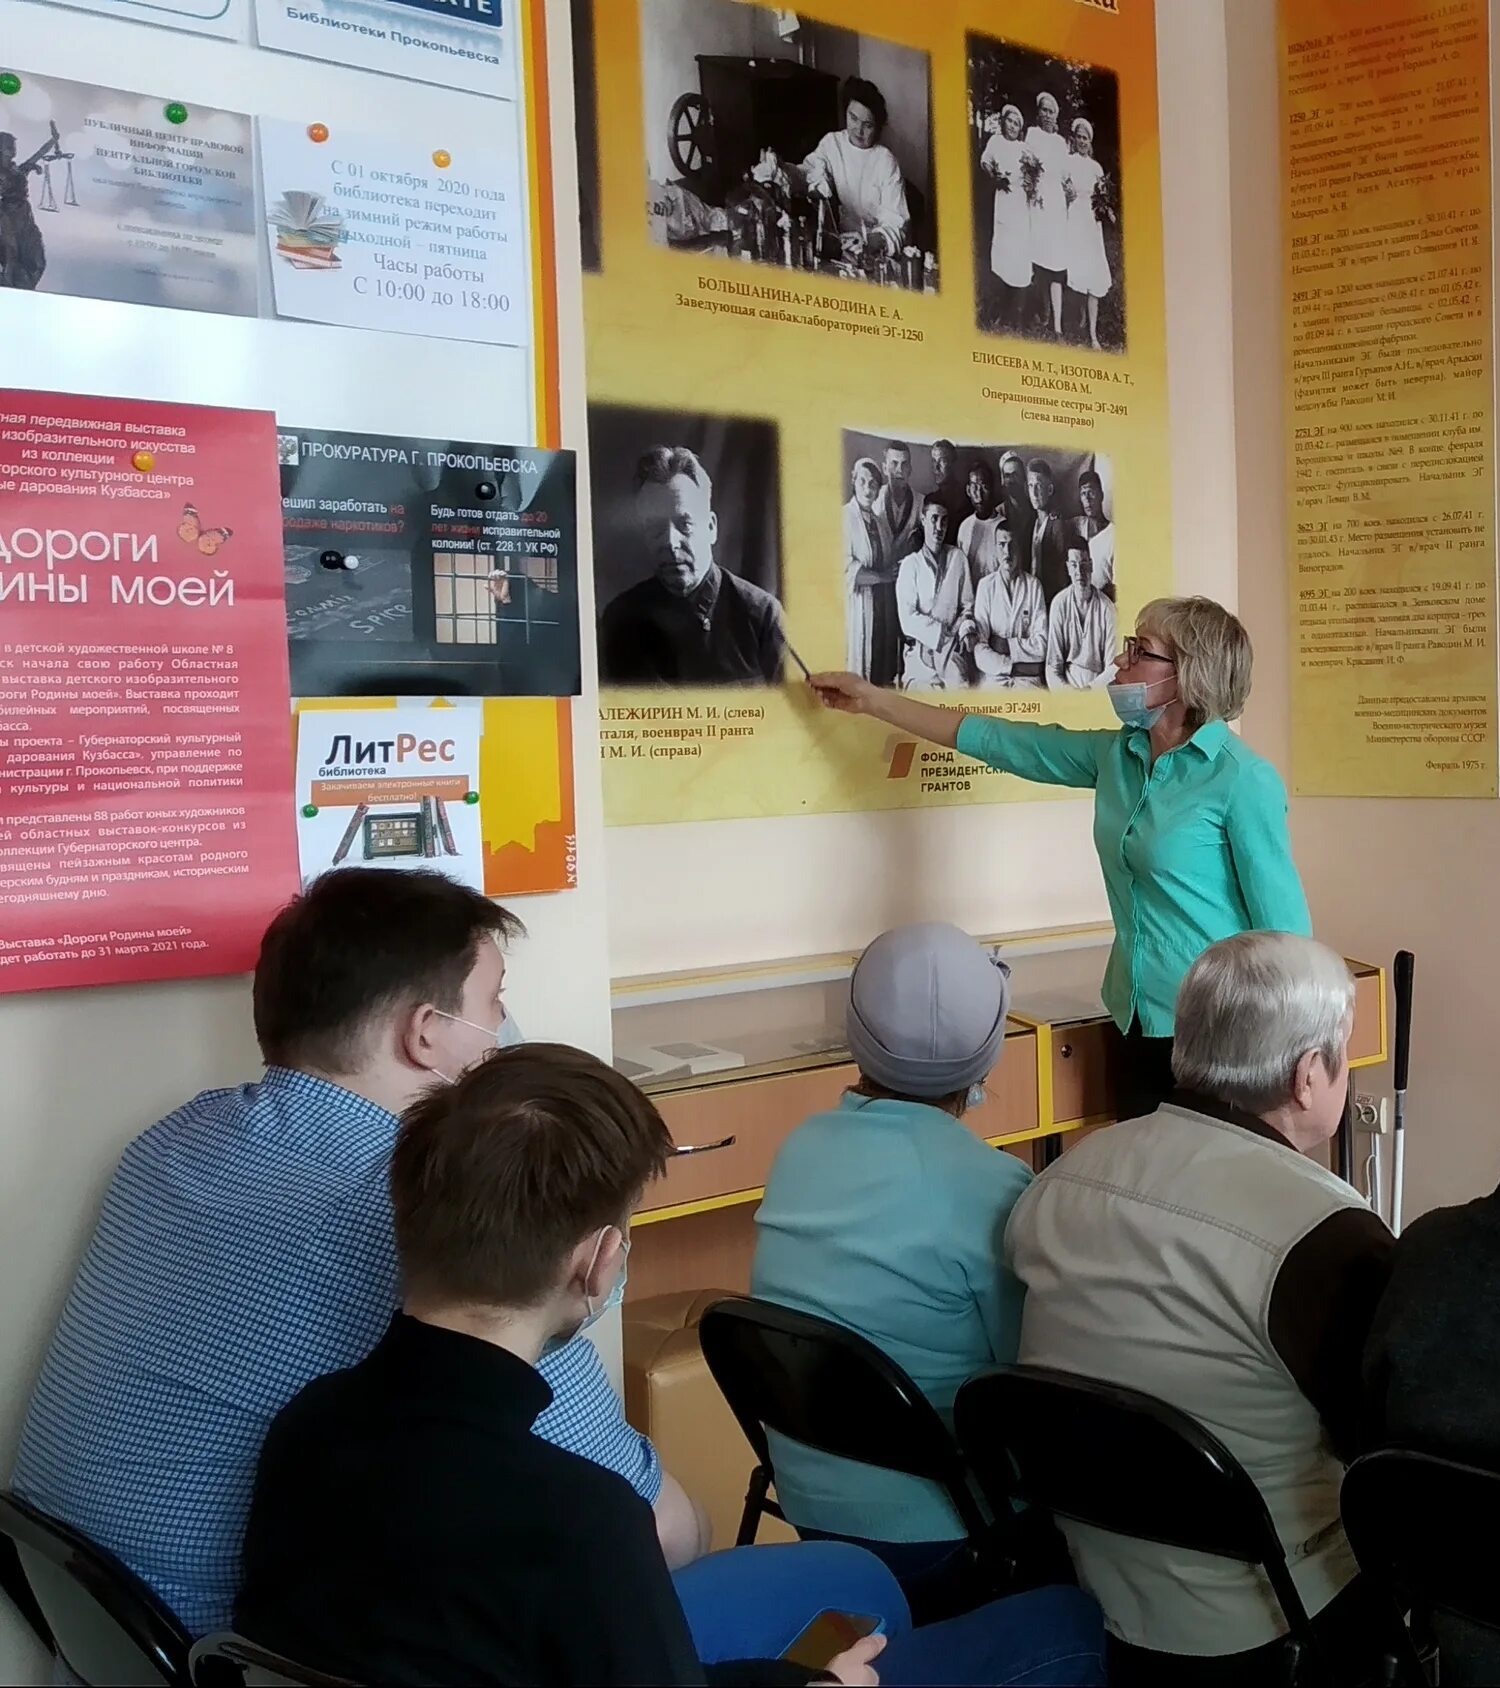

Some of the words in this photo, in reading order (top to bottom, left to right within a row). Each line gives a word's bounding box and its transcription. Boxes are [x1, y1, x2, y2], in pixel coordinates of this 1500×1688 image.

[287, 7, 386, 39] Библиотеки
[391, 32, 499, 65] Прокопьевска
[331, 160, 343, 173] С
[348, 164, 363, 178] 01
[370, 171, 429, 190] октября
[438, 178, 470, 195] 2020
[474, 188, 505, 201] года
[333, 183, 420, 208] библиотека
[425, 200, 496, 221] переходит
[323, 206, 340, 216] на
[347, 209, 400, 226] зимний
[405, 217, 451, 232] режим
[456, 225, 508, 242] работы
[429, 241, 487, 260] пятница
[374, 253, 417, 274] Часы
[424, 264, 484, 283] работы
[353, 276, 368, 294] С
[376, 279, 425, 301] 10:00
[432, 291, 453, 305] до
[461, 291, 510, 312] 18:00
[698, 277, 876, 317] БОЛЬШАНИНА-РАВОДИНА
[880, 306, 890, 318] Е.
[892, 309, 904, 321] А.
[675, 294, 755, 317] Заведующая
[759, 308, 880, 336] санбаклабораторией
[882, 325, 924, 342] ЭГ-1250
[972, 352, 1029, 370] ЕЛИСЕЕВА
[1032, 360, 1044, 372] М.
[1048, 363, 1058, 376] Т.,
[1061, 365, 1110, 382] ИЗОТОВА
[1112, 372, 1121, 383] А.
[1124, 374, 1134, 386] Т.,
[1021, 375, 1077, 393] ЮДАКОВА
[1080, 383, 1092, 394] М.
[982, 387, 1059, 407] Операционные
[1061, 399, 1092, 413] сестры
[1096, 401, 1128, 416] ЭГ-2491
[30, 415, 121, 432] передвижная
[125, 422, 186, 436] выставка
[1021, 409, 1050, 422] (слева
[1053, 414, 1094, 428] направо)
[1, 429, 127, 448] изобразительного
[131, 441, 195, 454] искусства
[22, 449, 37, 458] из
[42, 451, 115, 465] коллекции
[301, 442, 408, 464] ПРОКУРАТУРА
[412, 451, 424, 466] Г.
[427, 452, 537, 475] ПРОКОПЬЕВСКА
[61, 467, 143, 483] культурного
[147, 475, 194, 487] центра
[19, 480, 96, 495] дарования
[101, 486, 171, 500] Кузбасса»
[280, 497, 315, 510] ешил
[319, 499, 387, 515] заработать
[390, 504, 404, 515] на
[431, 505, 455, 518] Будь
[457, 508, 483, 520] готов
[486, 509, 519, 523] отдать
[482, 526, 560, 539] исправительной
[432, 539, 475, 550] колонии!
[495, 540, 522, 553] 228.1
[526, 541, 538, 553] УК
[540, 542, 558, 555] РФ)
[112, 570, 234, 606] моей
[4, 644, 12, 652] в
[15, 643, 64, 654] детской
[68, 645, 168, 655] художественной
[172, 645, 208, 654] школе
[212, 645, 224, 654] №
[226, 645, 233, 654] 8
[23, 660, 69, 669] начала
[77, 660, 110, 669] свою
[118, 659, 164, 671] работу
[172, 659, 238, 669] Областная
[2, 675, 62, 684] выставка
[66, 675, 121, 686] детского
[126, 674, 238, 686] изобразительного
[31, 690, 78, 700] Родины
[126, 690, 180, 699] Выставка
[184, 690, 239, 700] проходит
[686, 707, 702, 719] М.
[707, 707, 720, 718] И.
[724, 706, 765, 720] (слева)
[1006, 703, 1041, 713] ЭГ-2491
[14, 737, 62, 747] проекта
[79, 734, 171, 747] Губернаторский
[176, 733, 241, 744] культурный
[642, 727, 702, 741] военврач
[720, 726, 754, 740] ранга
[325, 733, 456, 765] ЛитРес
[610, 746, 627, 758] М.
[631, 745, 646, 757] И.
[650, 744, 702, 759] (справа)
[921, 752, 954, 763] ФОНД
[76, 766, 154, 777] Прокопьевск,
[156, 764, 178, 774] при
[181, 762, 243, 774] поддержке
[318, 766, 386, 778] библиотека
[1426, 761, 1460, 771] Февраль
[1462, 761, 1479, 769] 1975
[921, 781, 971, 792] ГРАНТОВ
[368, 792, 417, 802] бесплатно!
[7, 812, 91, 826] представлены
[94, 811, 108, 821] 88
[110, 809, 144, 822] работ
[146, 809, 176, 819] юных
[179, 806, 245, 818] художников
[57, 933, 108, 947] «Дороги
[110, 930, 155, 942] Родины
[157, 926, 192, 937] моей»
[24, 950, 79, 964] работать
[81, 949, 95, 958] до
[99, 947, 111, 956] 31
[115, 944, 149, 955] марта
[152, 942, 178, 952] 2021
[181, 939, 209, 950] года.
